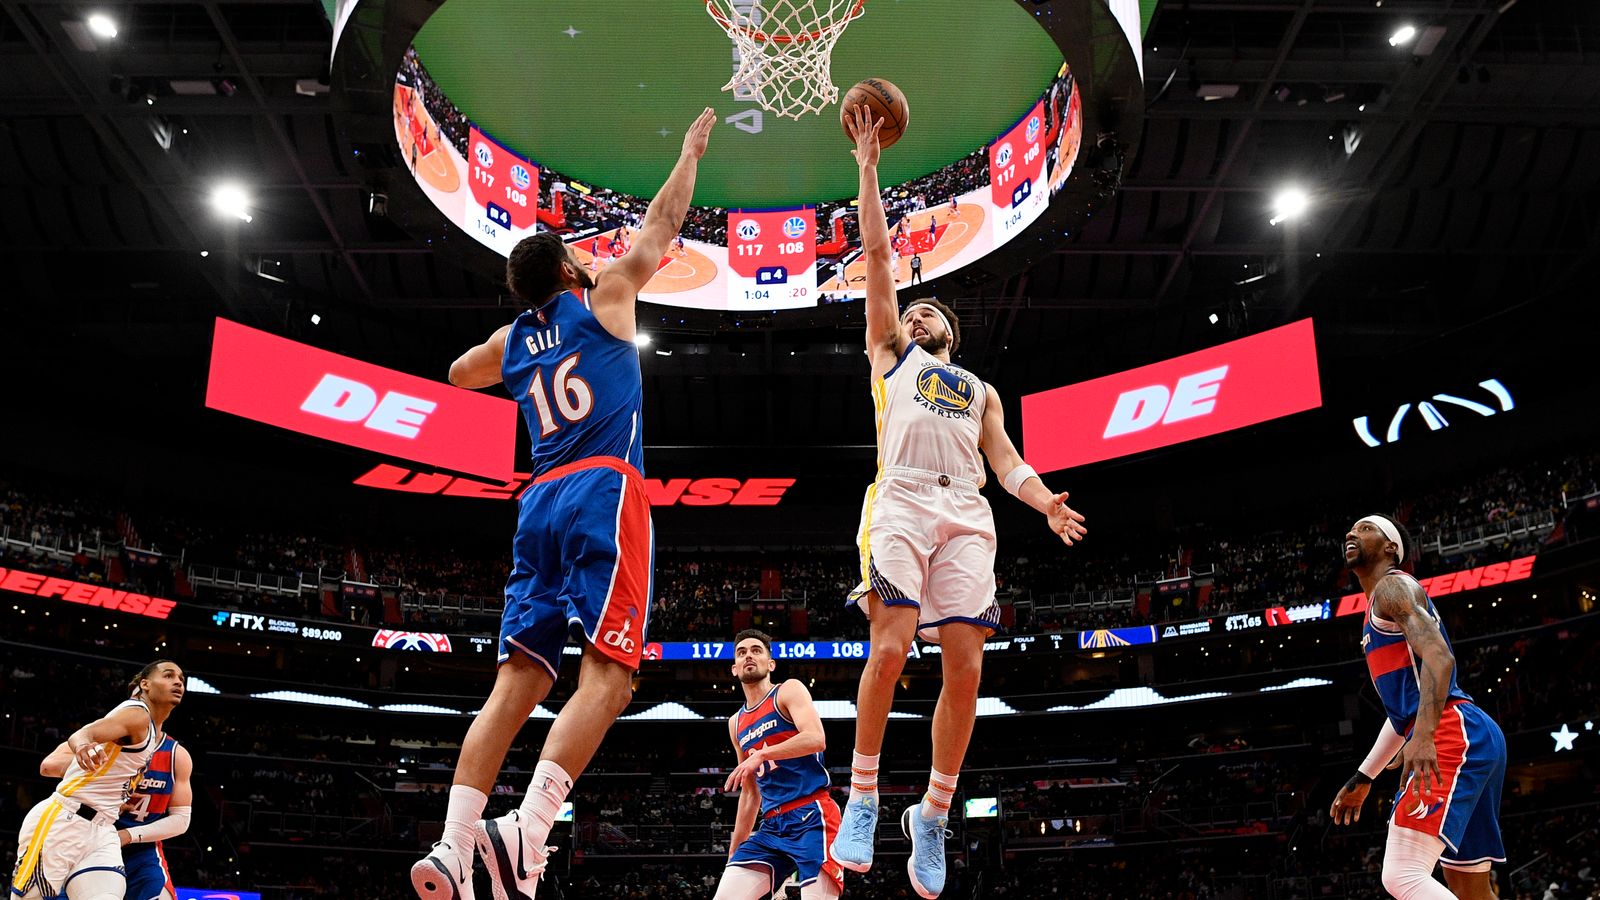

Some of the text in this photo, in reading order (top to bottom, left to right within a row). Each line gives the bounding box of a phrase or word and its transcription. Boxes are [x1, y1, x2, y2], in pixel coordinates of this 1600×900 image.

[1024, 142, 1039, 165] 108
[474, 166, 494, 187] 117
[997, 164, 1015, 186] 117
[505, 186, 527, 207] 108
[500, 212, 508, 223] 4
[477, 219, 496, 238] 1:04
[737, 244, 763, 256] 117
[778, 242, 804, 254] 108
[773, 269, 782, 279] 4
[745, 290, 770, 300] 1:04
[789, 287, 807, 297] :20
[525, 325, 561, 355] GILL
[528, 352, 594, 439] 16
[1102, 364, 1229, 440] DE
[300, 373, 438, 439] DE
[913, 393, 970, 420] WARRIORS
[0, 567, 177, 619] EFENSE
[230, 612, 265, 631] FTX
[268, 619, 296, 627] BLOCKS
[302, 626, 342, 641] $89,000
[692, 643, 723, 658] 117
[779, 643, 816, 658] 1:04
[832, 642, 863, 658] 108
[1054, 641, 1060, 649] 1
[739, 719, 777, 747] ashington
